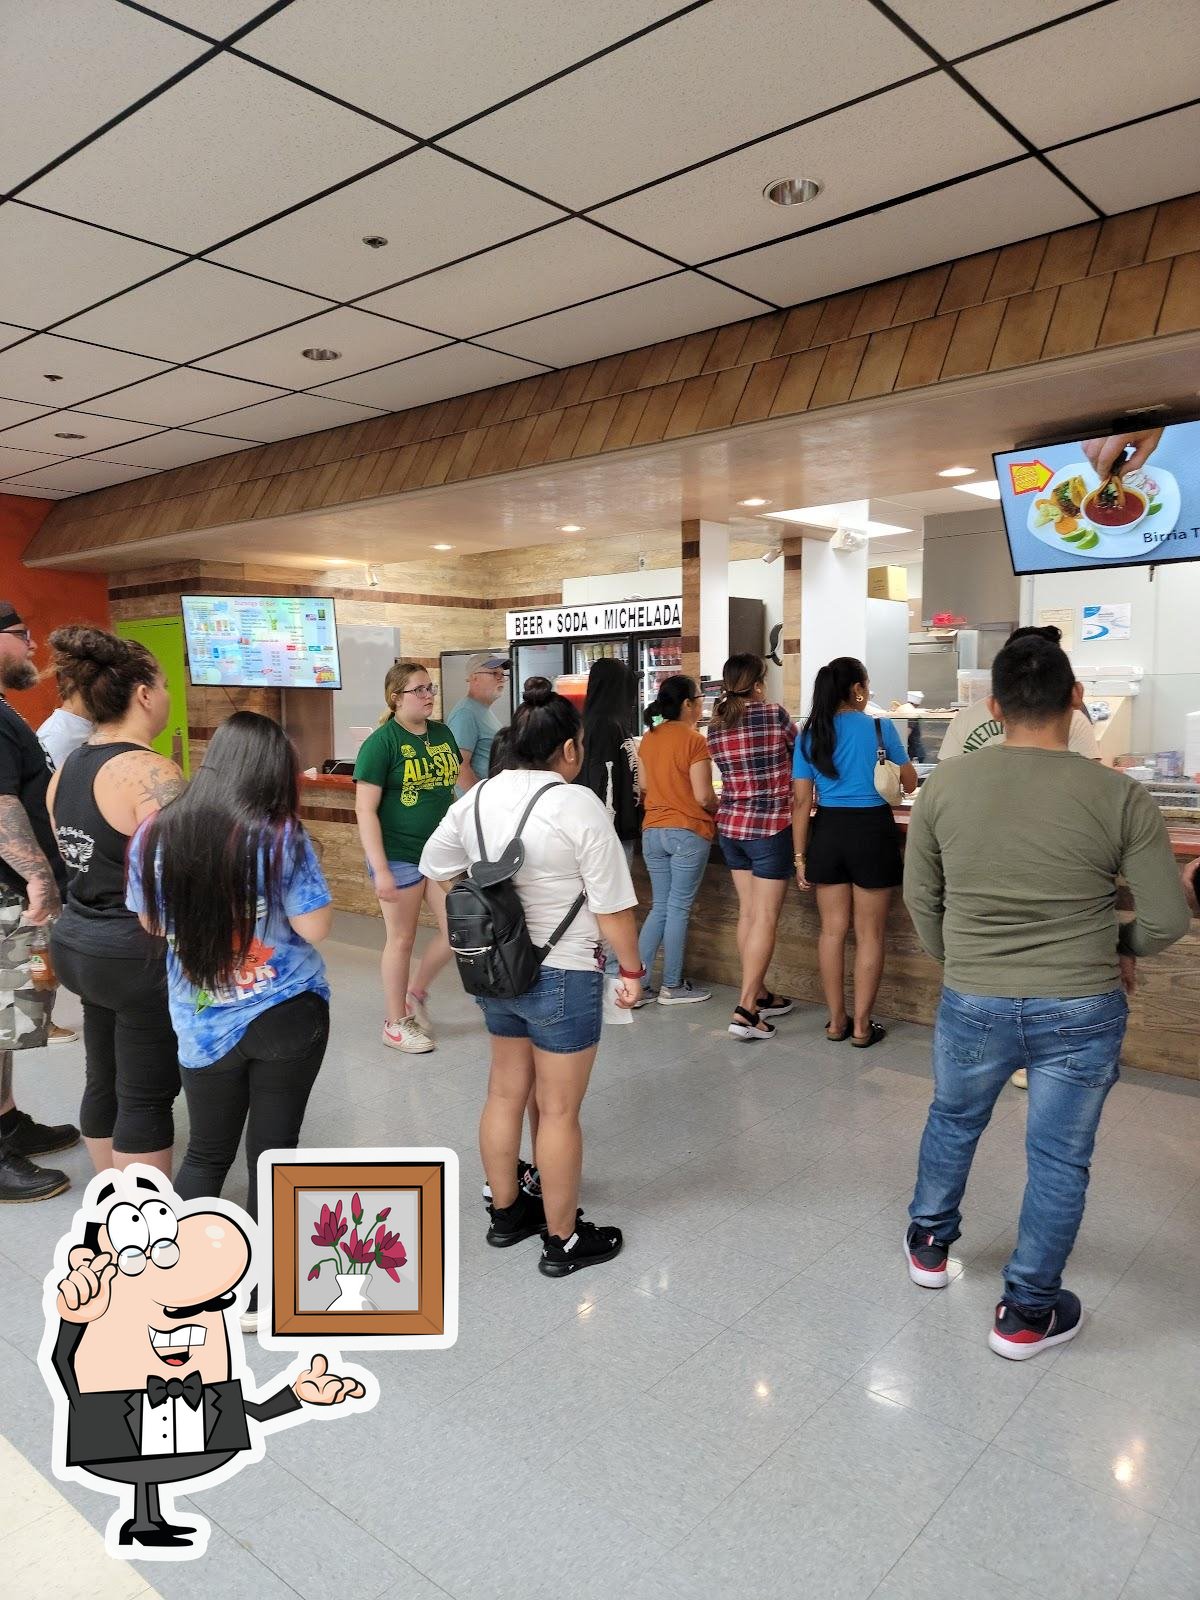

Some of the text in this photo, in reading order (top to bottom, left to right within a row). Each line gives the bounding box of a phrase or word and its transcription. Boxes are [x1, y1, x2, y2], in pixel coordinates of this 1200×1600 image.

[1143, 529, 1187, 543] Birria
[515, 603, 681, 636] BEER SODA MICHELADA
[403, 757, 433, 783] ALL
